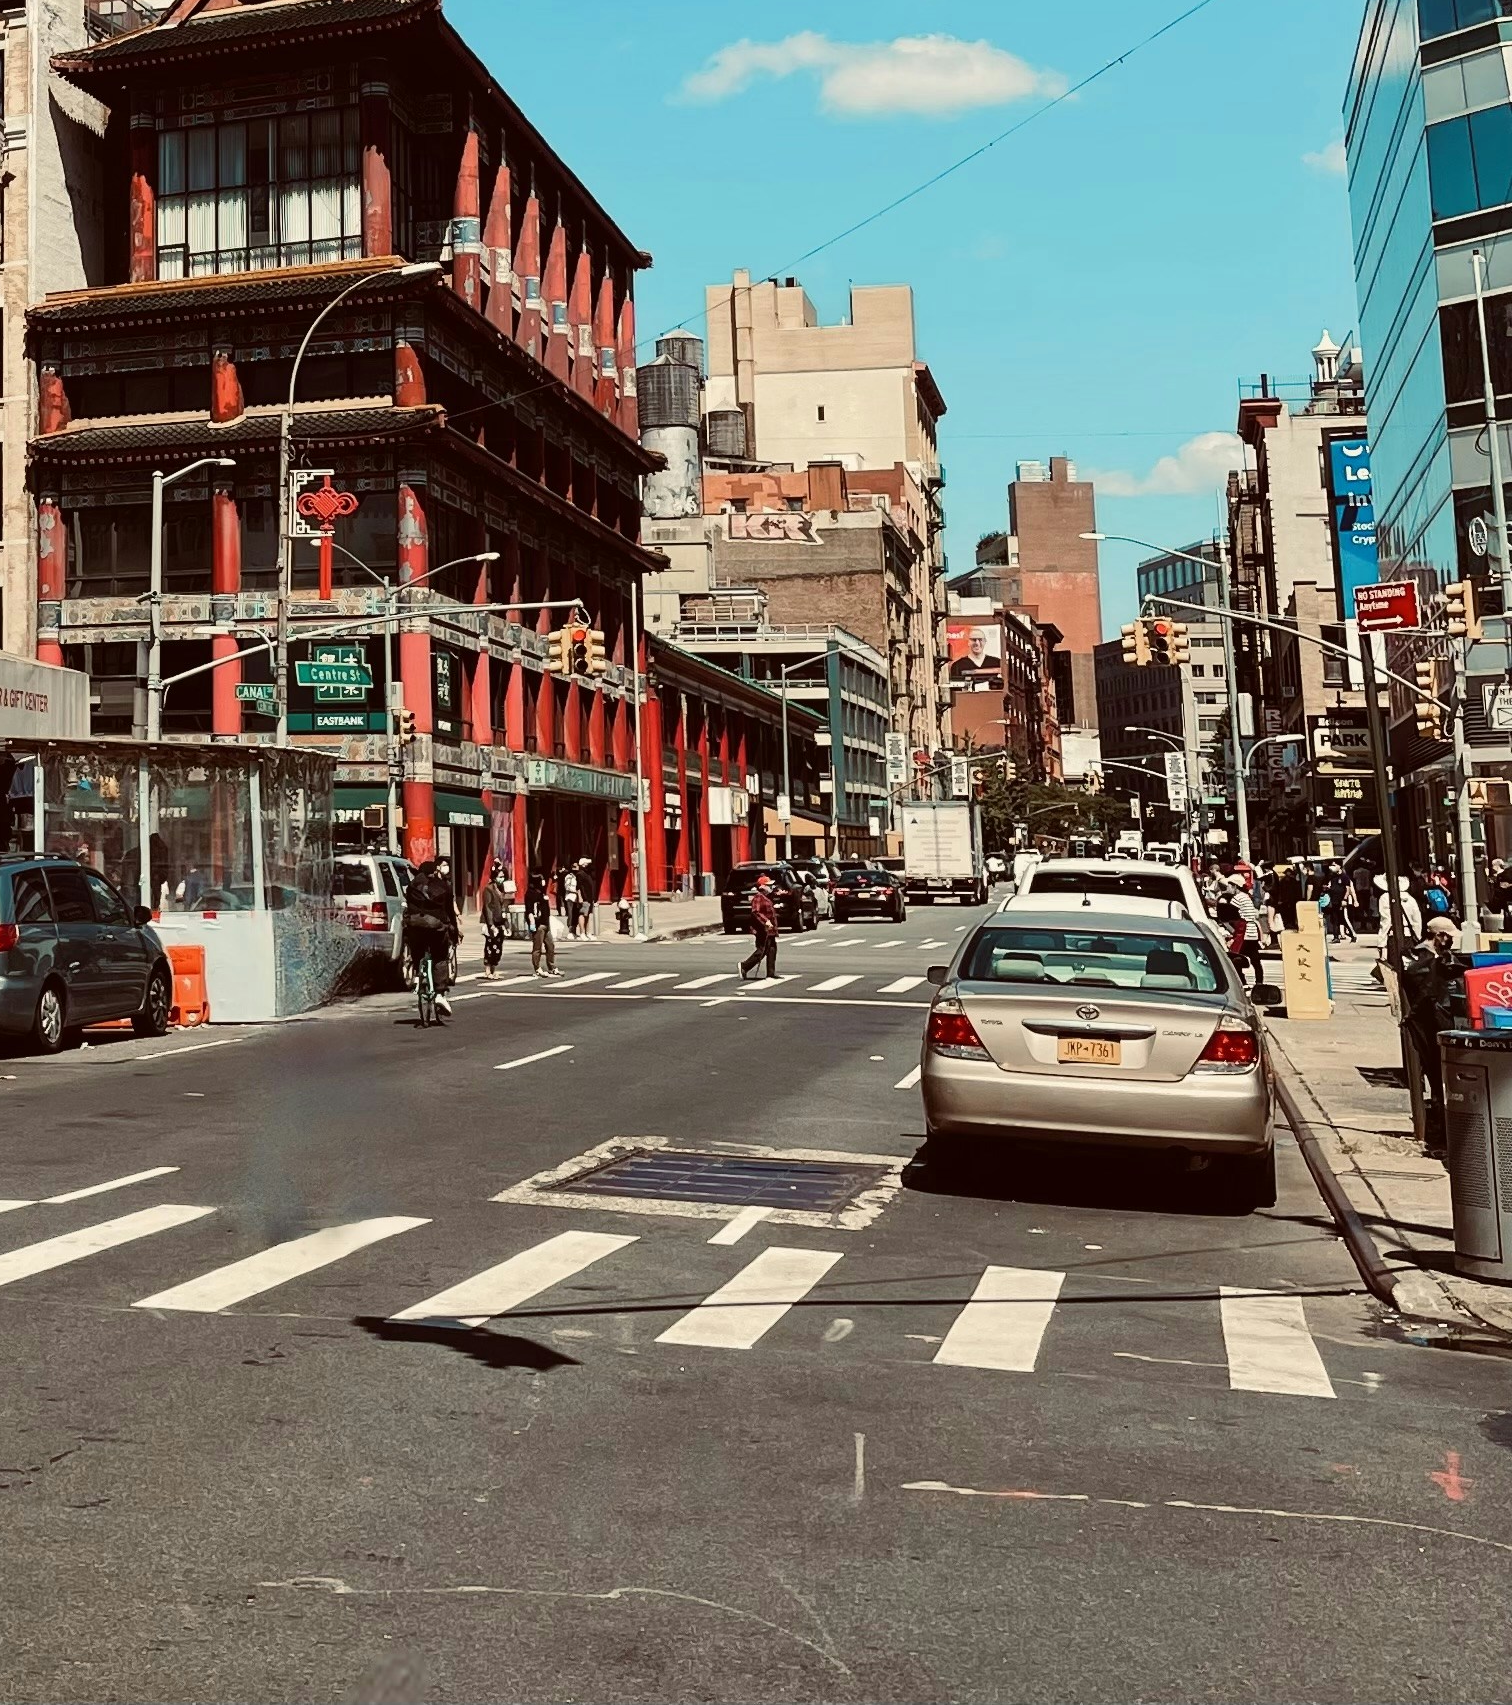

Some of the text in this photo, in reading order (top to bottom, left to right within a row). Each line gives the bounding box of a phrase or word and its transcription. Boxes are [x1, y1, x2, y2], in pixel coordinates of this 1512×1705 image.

[1345, 465, 1372, 481] Le
[1369, 587, 1406, 600] STANDING
[310, 667, 361, 682] Centre St
[236, 685, 268, 698] CANAL
[3, 688, 9, 707] &
[9, 690, 24, 709] GIFT
[24, 692, 49, 713] CENTER
[317, 716, 364, 726] EASTBANK
[1320, 733, 1367, 747] PARK
